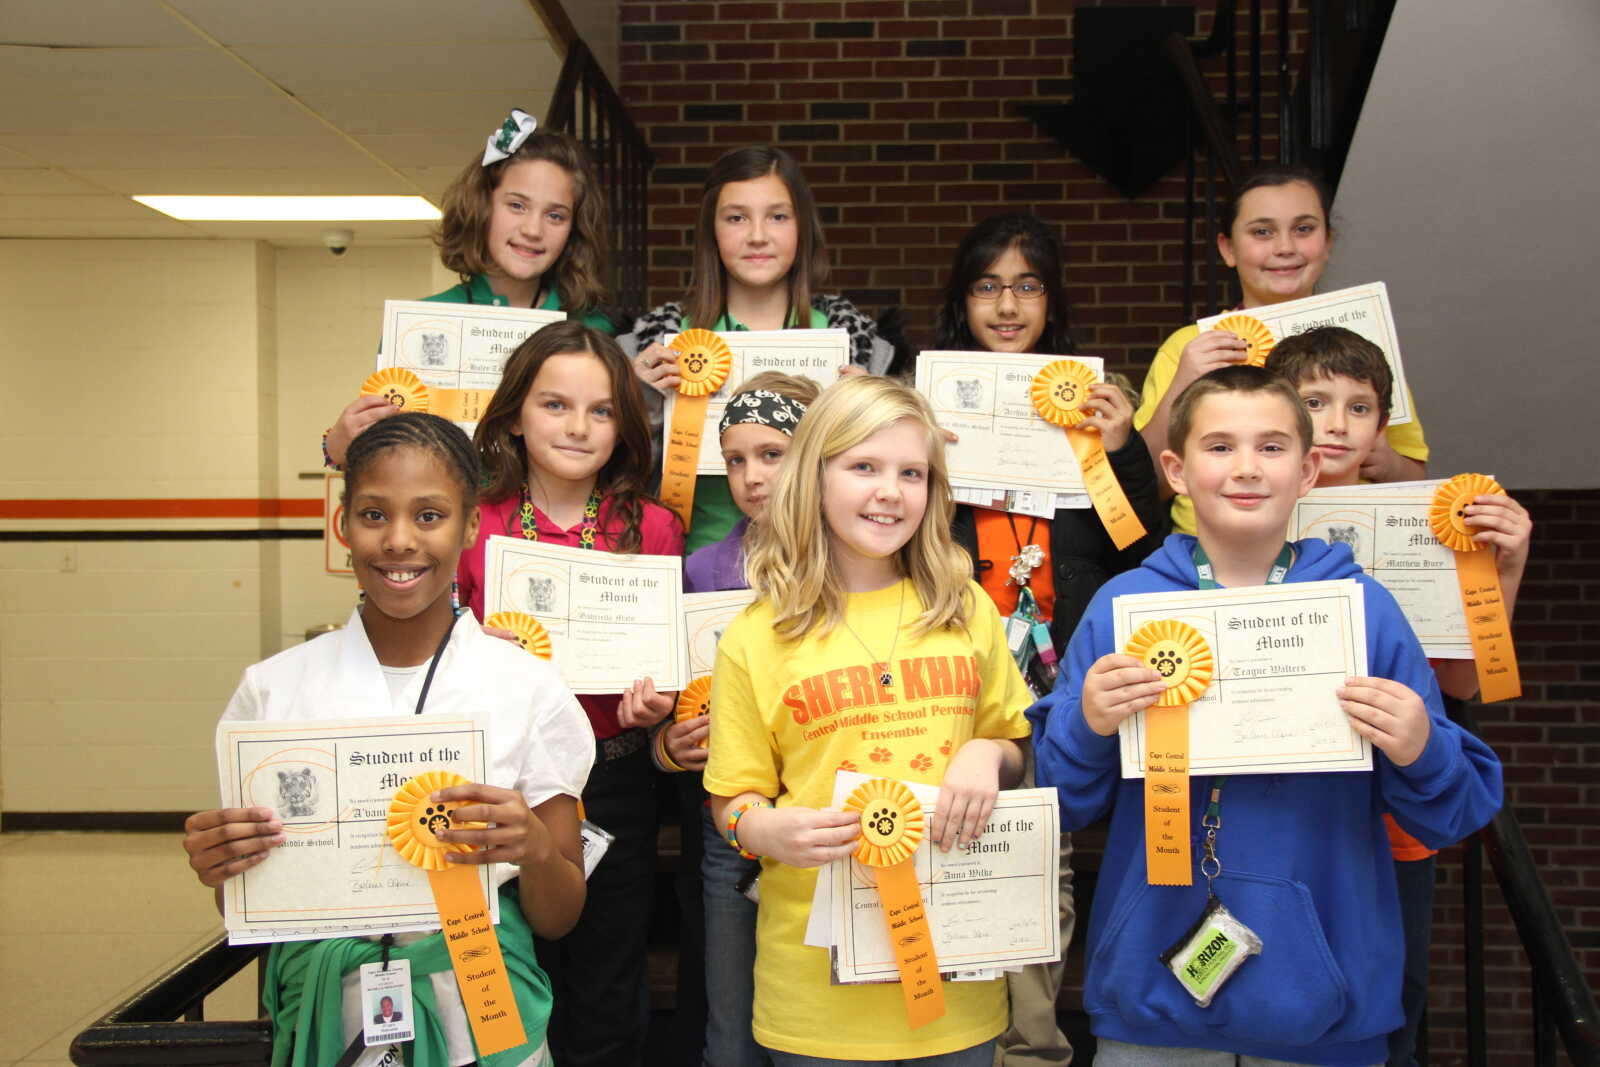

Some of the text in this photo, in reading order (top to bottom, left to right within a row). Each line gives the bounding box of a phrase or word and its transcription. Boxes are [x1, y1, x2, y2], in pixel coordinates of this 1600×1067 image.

[1290, 310, 1367, 336] Student of the
[470, 326, 527, 339] Student of
[752, 356, 828, 367] Student of the
[1005, 371, 1033, 382] Stud
[1385, 514, 1429, 528] Stude
[1407, 533, 1440, 547] Mon
[1386, 559, 1421, 568] Matthew
[579, 572, 659, 589] Student of the
[1478, 585, 1497, 593] Central
[600, 591, 638, 603] Month
[1484, 597, 1500, 605] School
[1227, 611, 1329, 630] Student of the
[1478, 631, 1503, 640] Student
[1255, 634, 1304, 651] Month
[1232, 663, 1307, 678] Teague Walters
[1485, 666, 1508, 675] Month
[782, 661, 897, 725] SHERE
[802, 720, 839, 742] Central
[838, 711, 879, 729] Middle
[883, 706, 927, 724] School
[861, 725, 928, 742] Ensemble
[349, 747, 461, 766] Student of the
[1149, 751, 1184, 760] Cape Central
[1148, 764, 1186, 774] Middle School
[1153, 805, 1181, 814] Student
[1000, 819, 1012, 833] of
[1016, 819, 1035, 832] the
[1163, 819, 1171, 827] of
[307, 838, 334, 848] School
[965, 840, 1010, 855] Month
[1155, 845, 1180, 855] Month
[944, 868, 993, 880] Anna Wilke
[854, 901, 879, 910] Central
[889, 901, 920, 917] Cape Central
[446, 909, 485, 927] Cape Central
[891, 913, 924, 929] Middle School
[449, 924, 490, 942] Middle School
[903, 951, 929, 965] Student
[1186, 932, 1228, 978] HRIZON
[466, 967, 497, 982] Student
[915, 965, 923, 974] of
[481, 984, 490, 993] of
[916, 979, 927, 987] the
[912, 987, 934, 1000] Month
[483, 999, 496, 1008] the
[480, 1009, 507, 1023] Month
